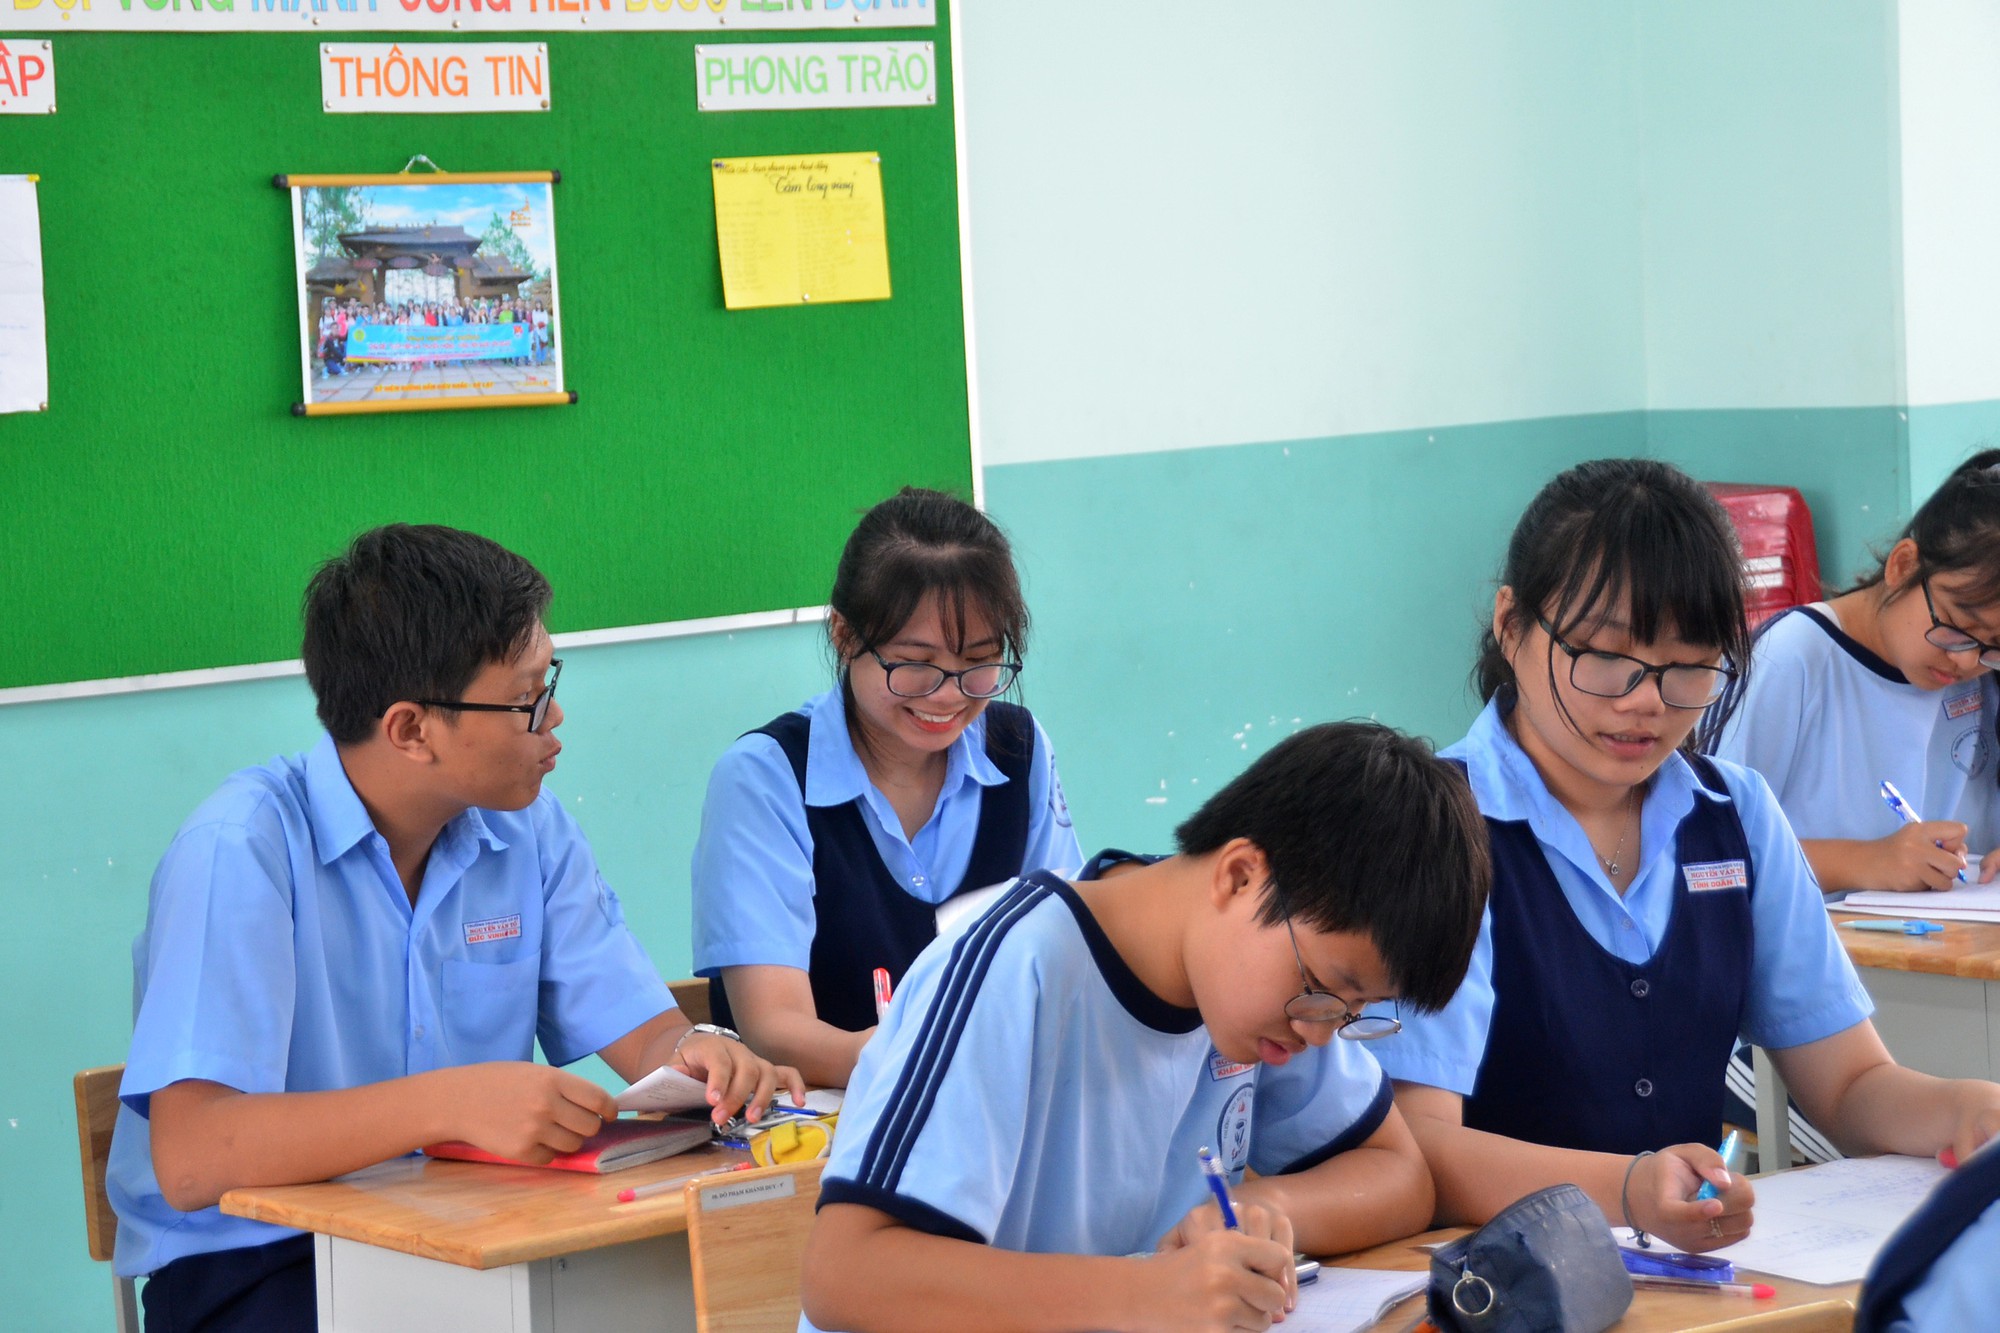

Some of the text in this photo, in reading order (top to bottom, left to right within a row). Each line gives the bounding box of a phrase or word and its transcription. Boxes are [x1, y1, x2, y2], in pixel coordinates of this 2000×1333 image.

[329, 43, 543, 97] THÔNG TIN
[704, 46, 929, 96] PHONG TRÀO
